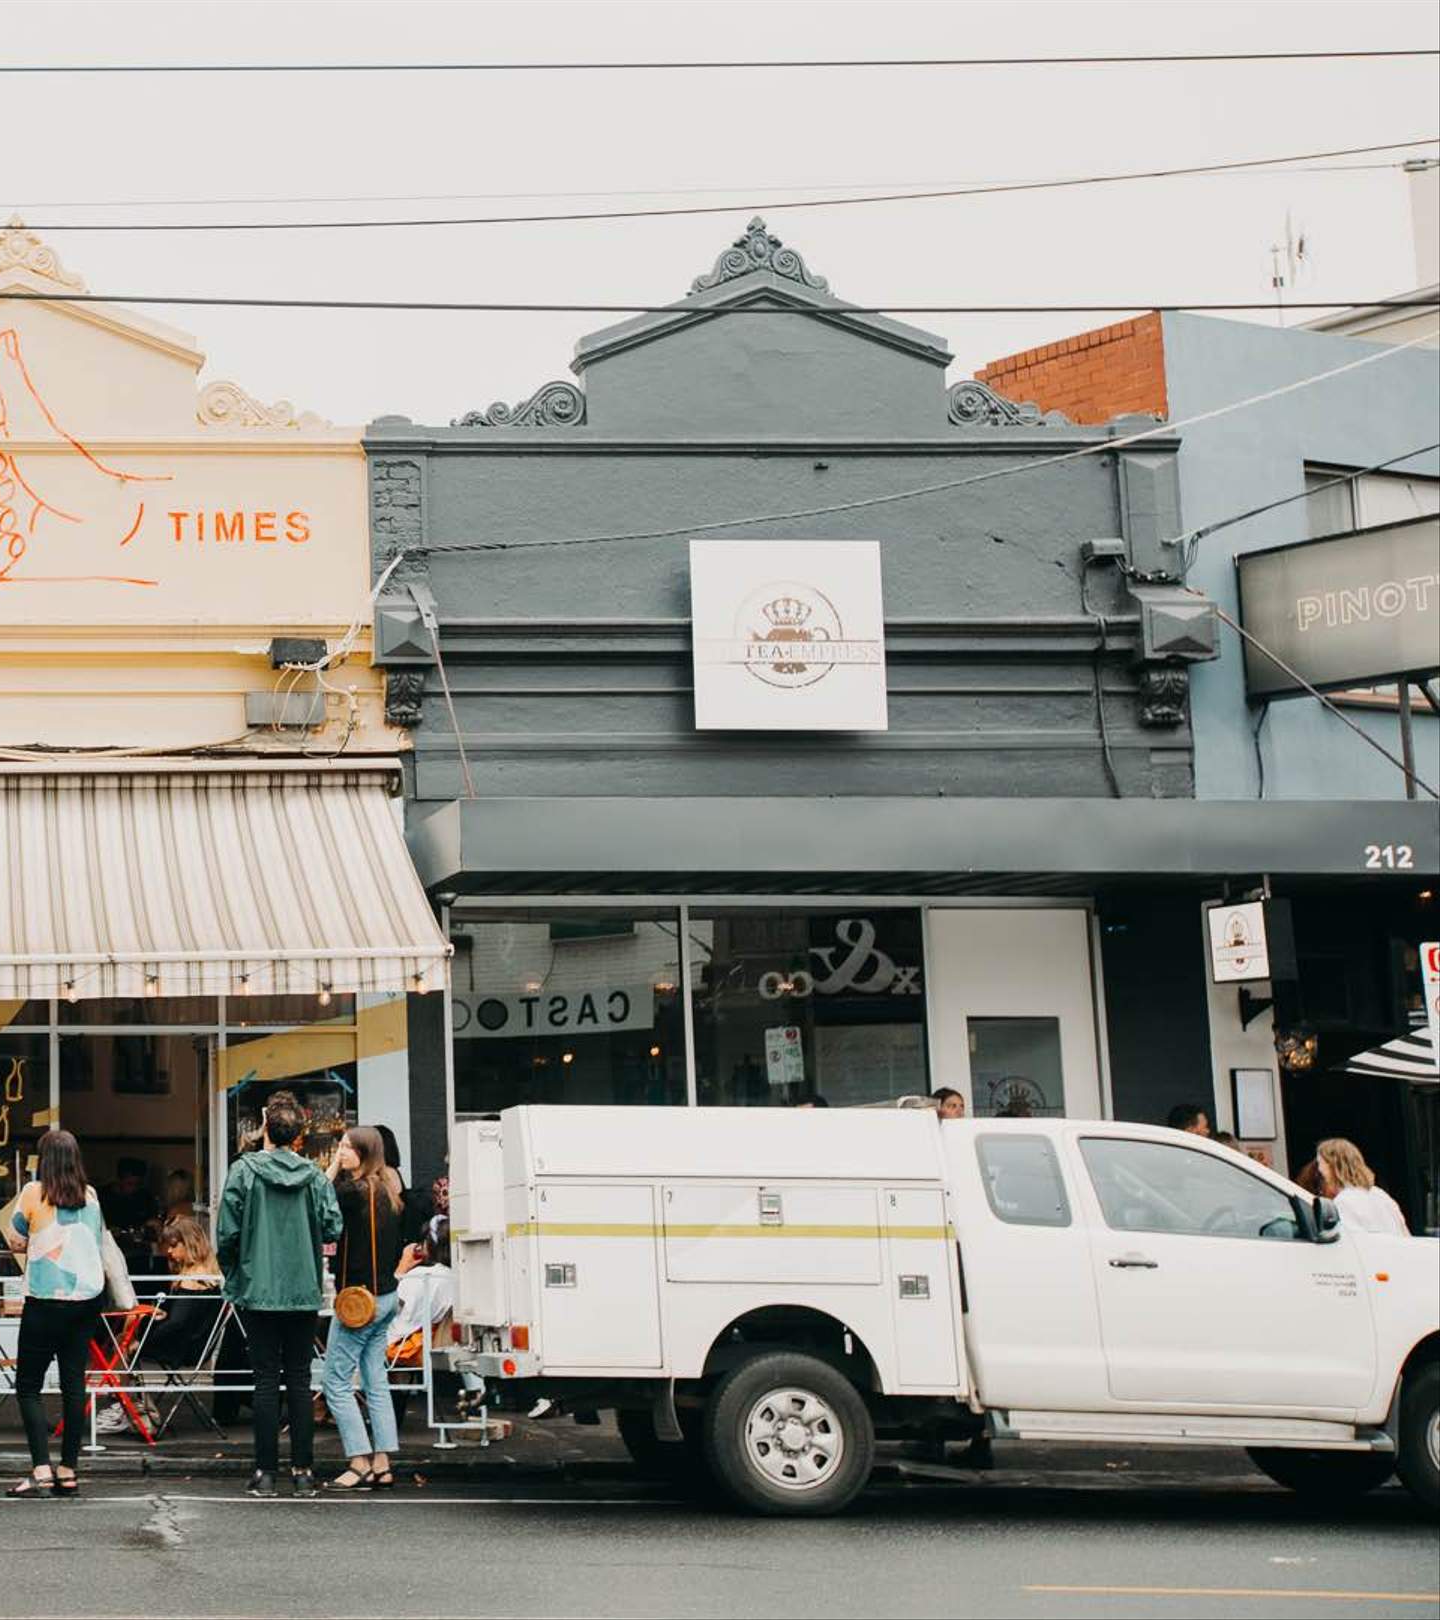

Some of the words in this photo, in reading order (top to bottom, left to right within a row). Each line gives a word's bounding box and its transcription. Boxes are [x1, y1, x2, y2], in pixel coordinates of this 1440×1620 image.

[167, 511, 311, 543] TIMES
[1296, 574, 1440, 632] PINOT
[1364, 844, 1414, 869] 212
